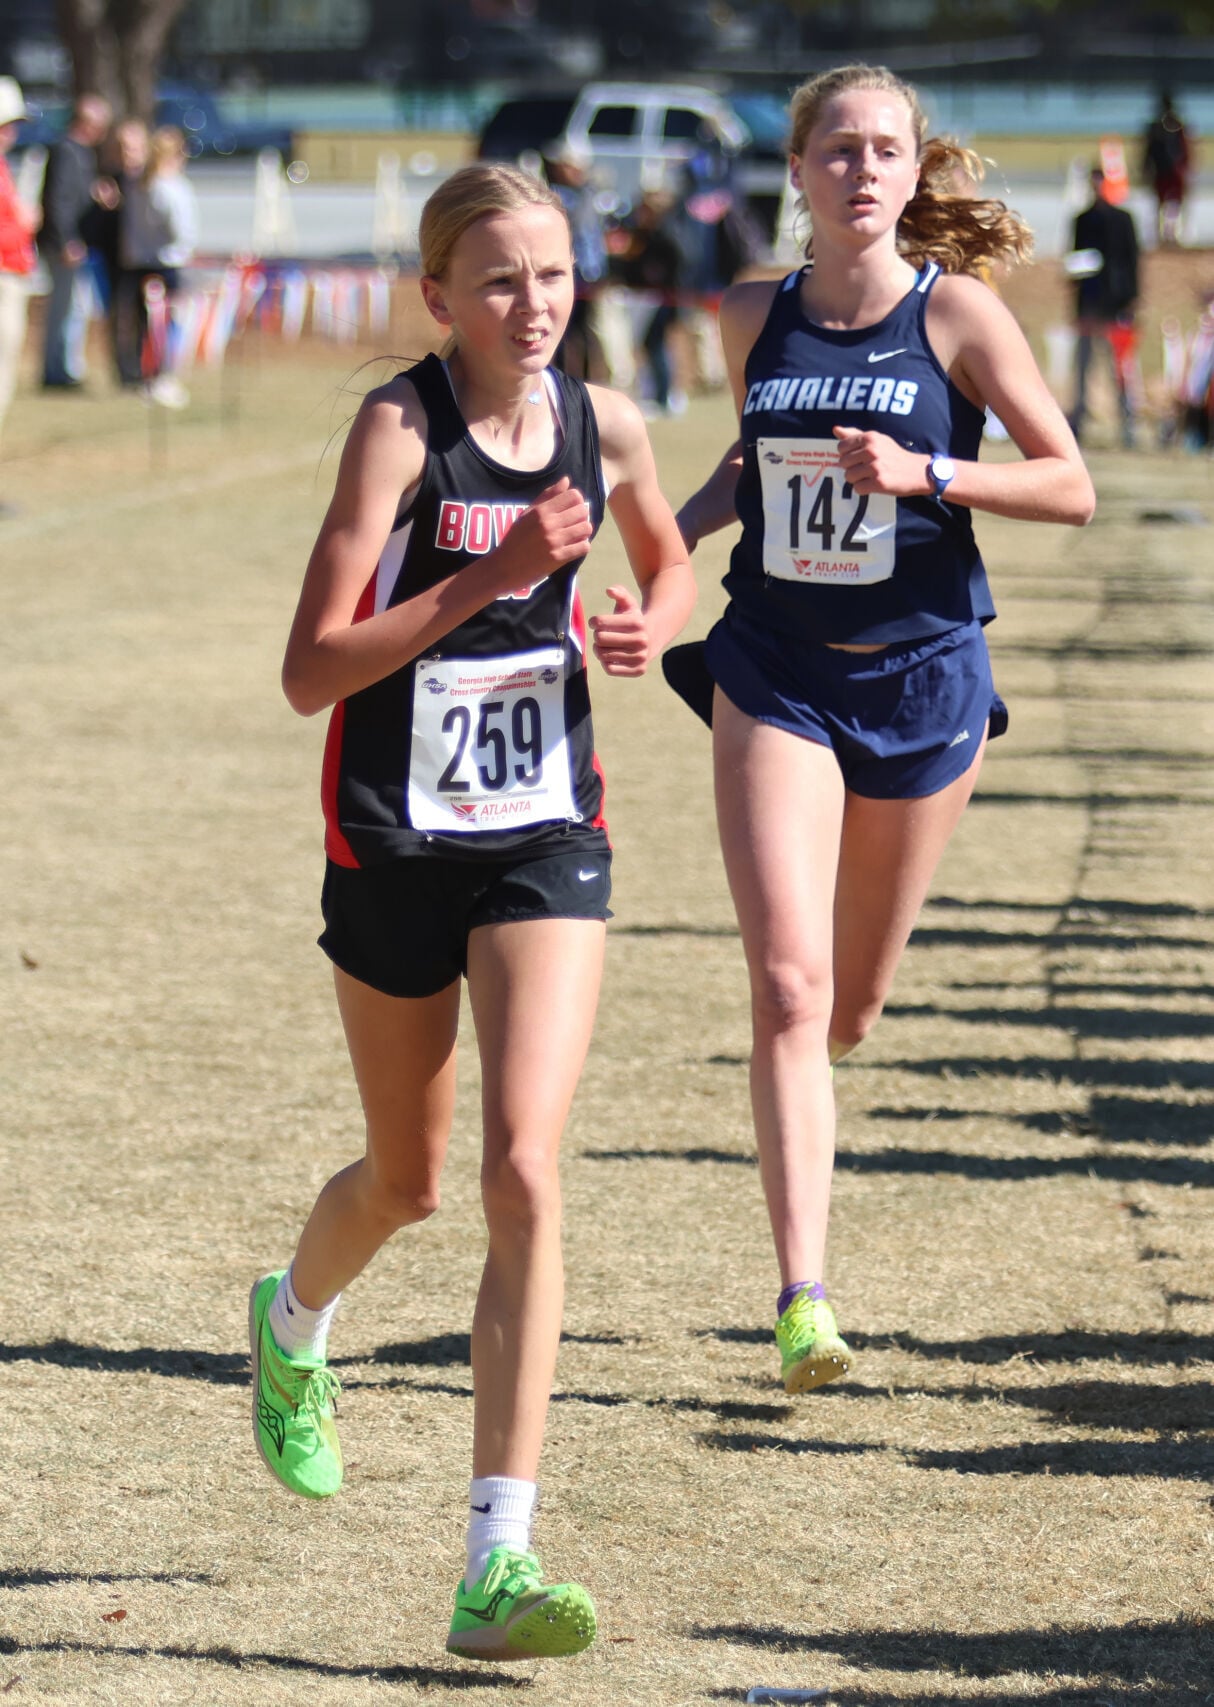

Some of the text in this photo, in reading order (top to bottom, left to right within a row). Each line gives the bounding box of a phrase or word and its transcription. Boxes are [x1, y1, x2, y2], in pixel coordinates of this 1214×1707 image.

[743, 376, 919, 416] CAVALIERS
[787, 474, 870, 552] 142
[814, 561, 860, 573] ATLANTA
[457, 671, 533, 686] Georgia High School State
[450, 687, 470, 697] Cross
[469, 685, 492, 695] Country
[436, 696, 544, 793] 259
[480, 800, 532, 816] ATLANTA
